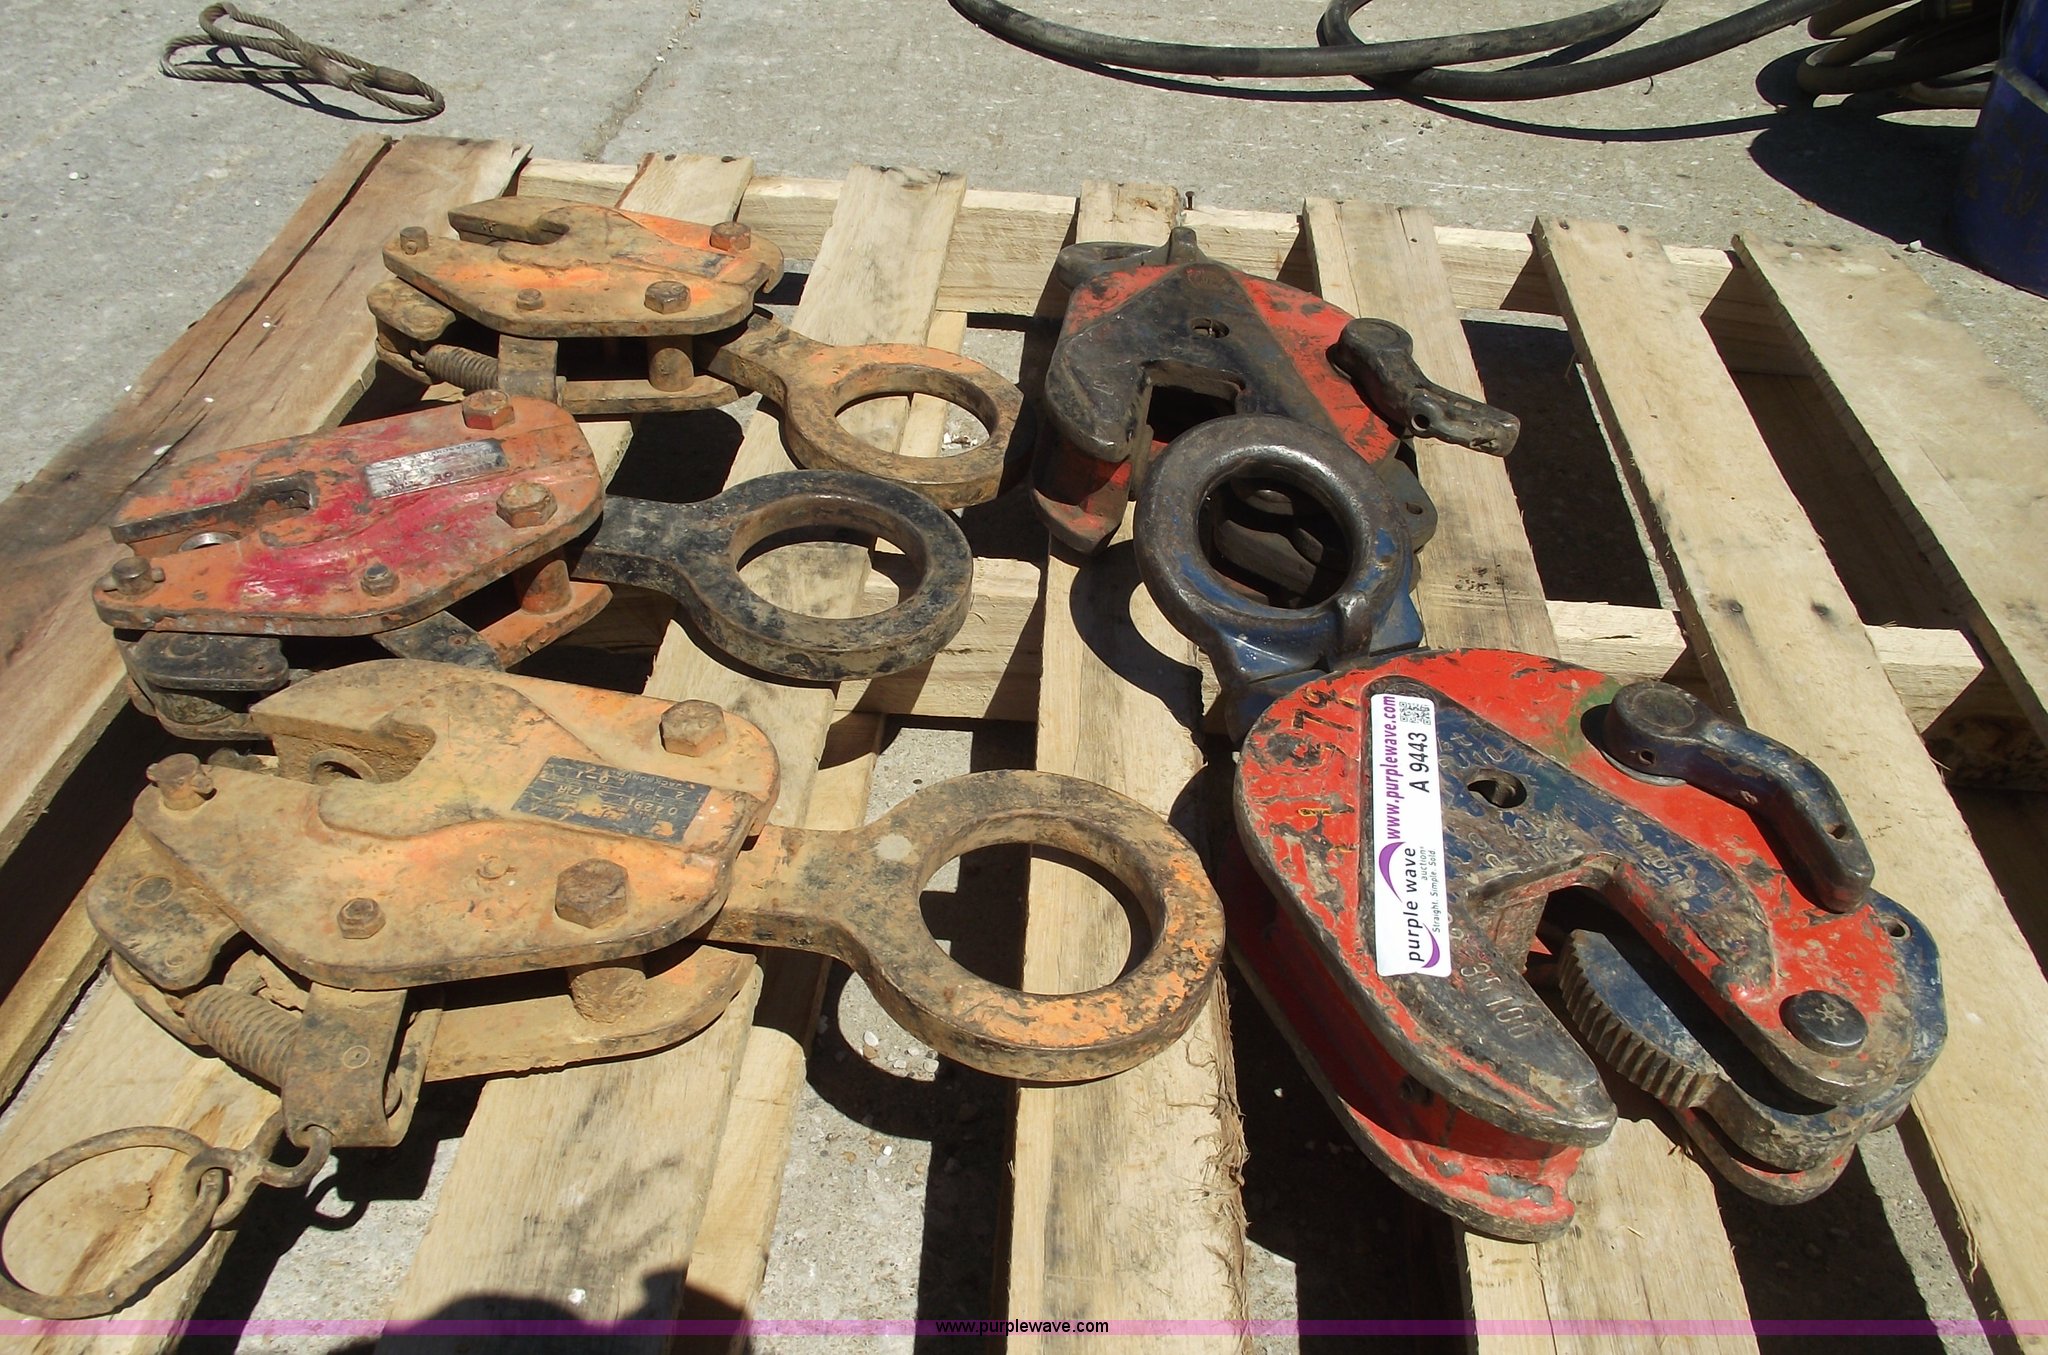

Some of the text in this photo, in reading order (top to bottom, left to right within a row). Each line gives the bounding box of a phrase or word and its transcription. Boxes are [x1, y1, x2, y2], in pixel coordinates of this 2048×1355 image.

[1380, 696, 1405, 839] www.purplewave.com
[1408, 732, 1429, 793] A 9443
[1402, 847, 1424, 962] purple wave
[1429, 867, 1438, 897] Simple.
[1431, 900, 1440, 933] Straight.
